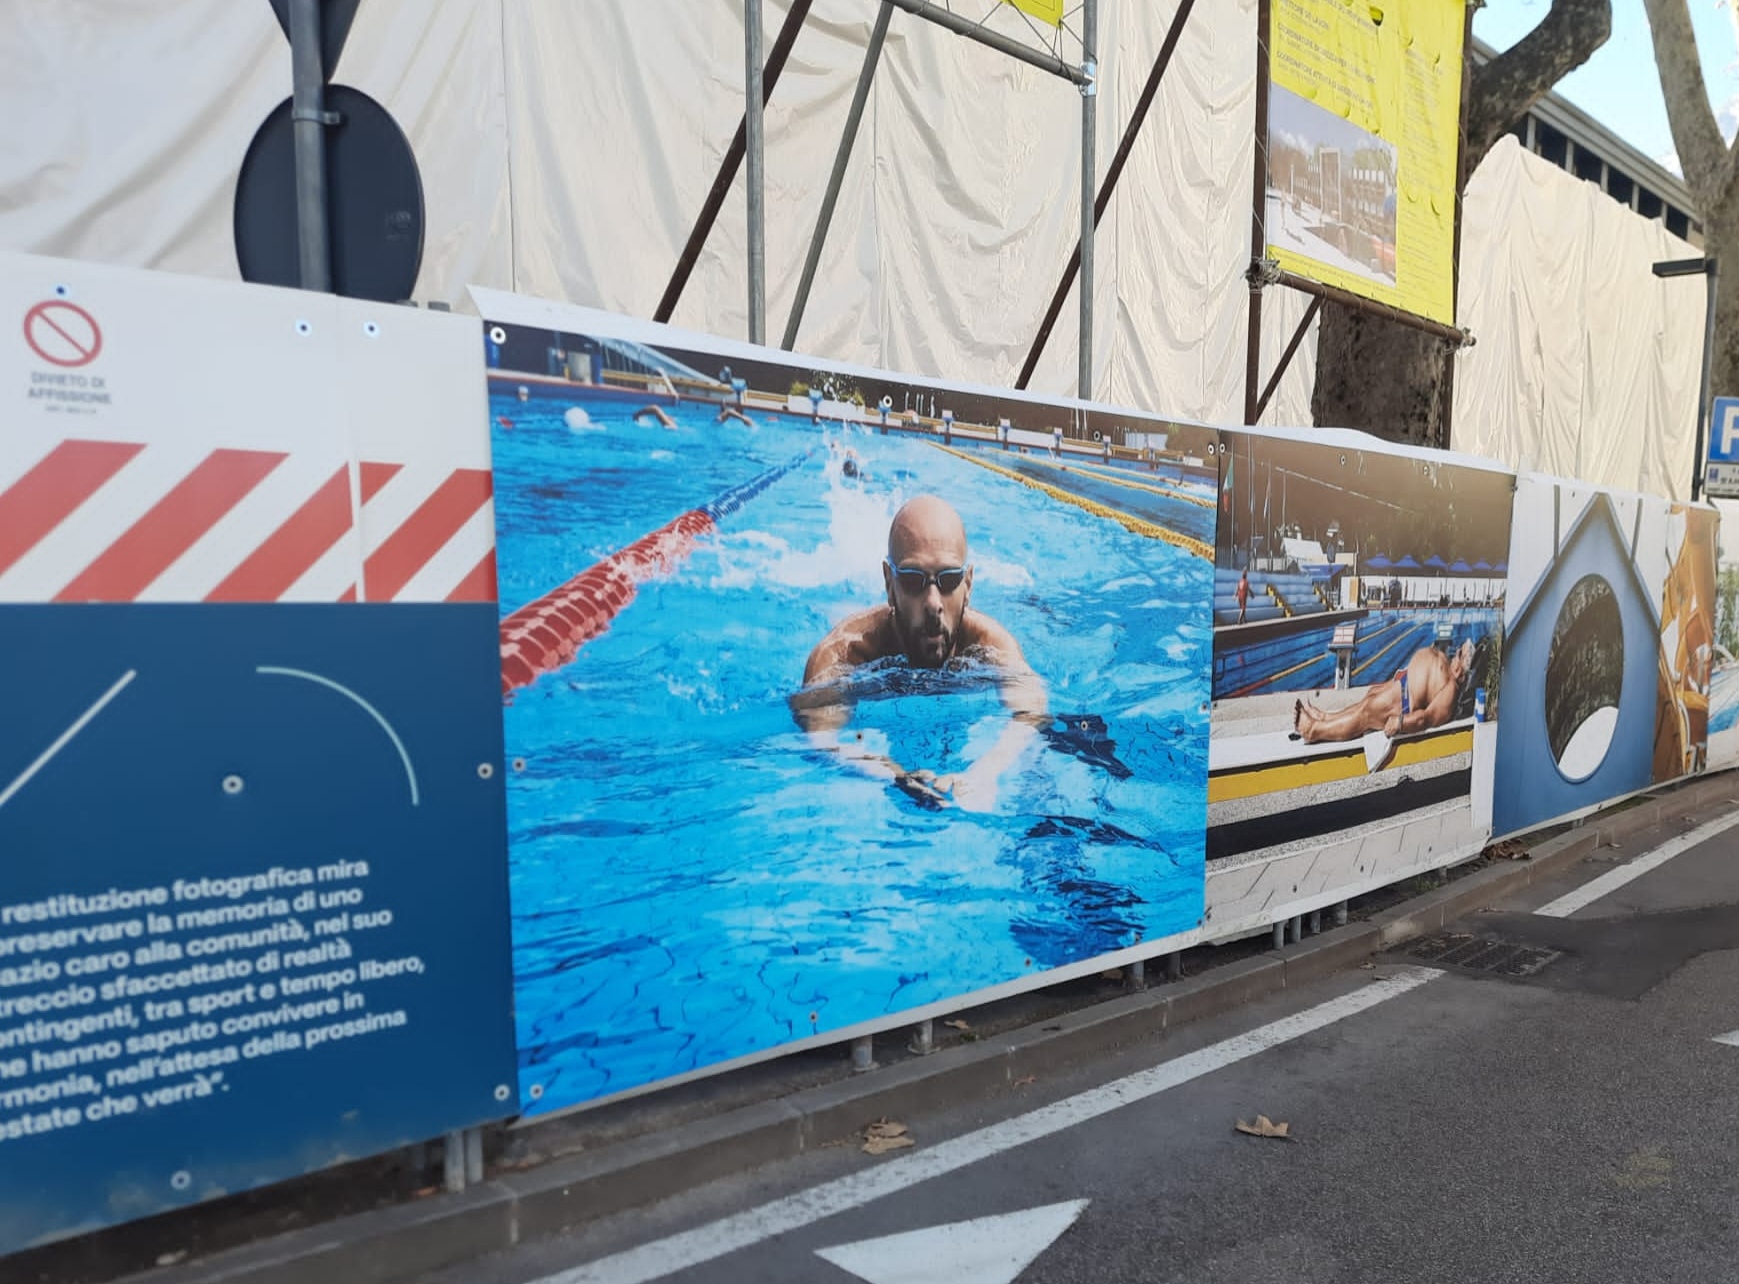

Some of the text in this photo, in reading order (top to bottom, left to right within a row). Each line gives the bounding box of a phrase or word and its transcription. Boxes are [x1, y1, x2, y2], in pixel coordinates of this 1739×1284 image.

[1720, 405, 1739, 455] P
[2, 859, 369, 924] restituzione fotografica mira
[147, 912, 173, 934] la
[176, 896, 290, 930] memoria
[293, 891, 315, 912] di
[319, 888, 363, 908] uno
[65, 951, 130, 976] caro
[134, 940, 183, 965] alla
[186, 918, 310, 957] comunità,
[314, 912, 349, 936] nel
[352, 910, 392, 930] suo
[100, 958, 252, 1000] sfaccettato
[256, 951, 280, 973] di
[283, 937, 352, 968] realtà
[144, 1000, 183, 1021] tra
[187, 983, 256, 1016] sport
[259, 983, 276, 1000] e
[280, 968, 356, 996] tempo
[359, 956, 425, 981] libero,
[32, 1041, 121, 1072] hanno
[126, 1021, 218, 1054] saputo
[221, 998, 340, 1035] convivere
[343, 991, 365, 1012] in
[242, 1030, 301, 1059] della
[305, 1010, 407, 1050] prossima
[85, 1095, 138, 1121] che
